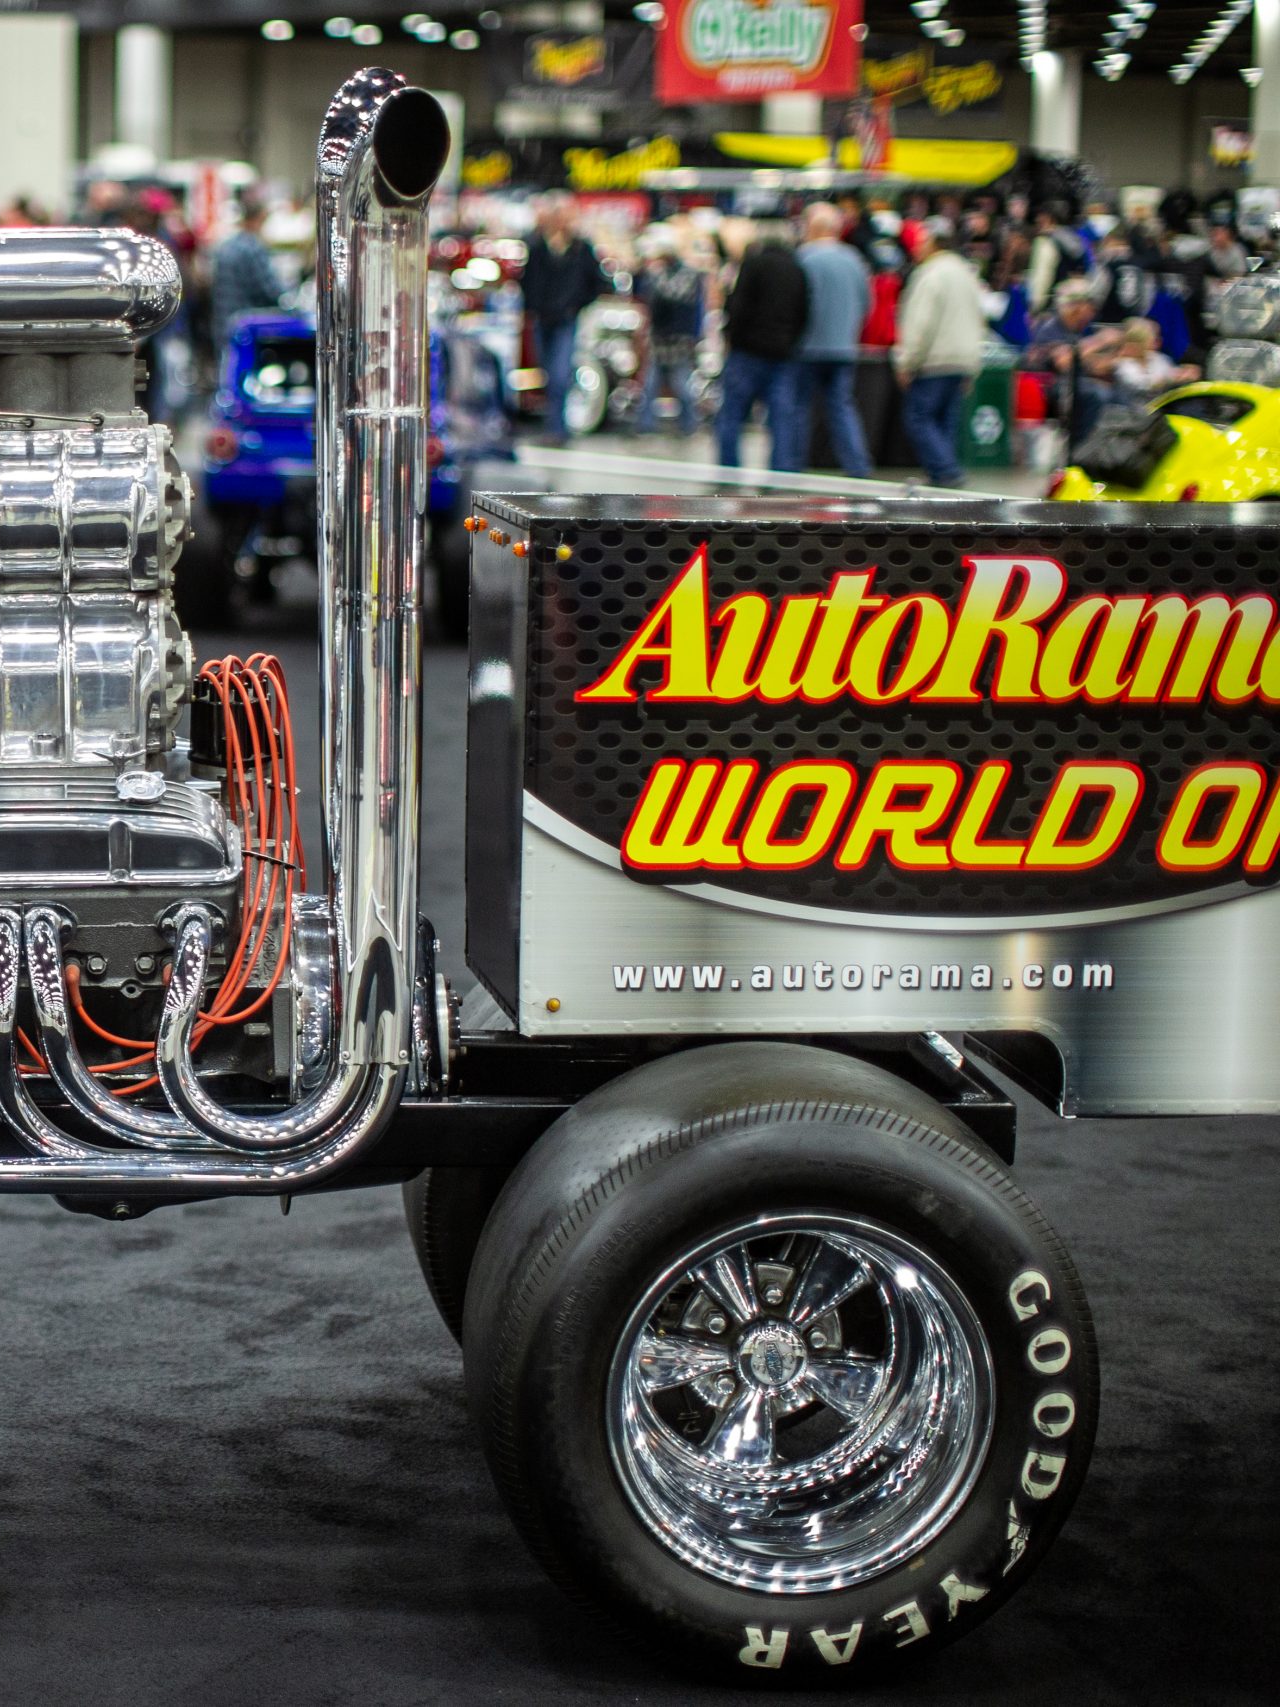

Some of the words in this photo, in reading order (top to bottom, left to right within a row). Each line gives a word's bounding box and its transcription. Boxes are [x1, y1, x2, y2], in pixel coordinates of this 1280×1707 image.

[574, 540, 1280, 704] AutoRam
[622, 759, 1144, 872] WORLD
[612, 960, 1116, 991] www.autorama.com
